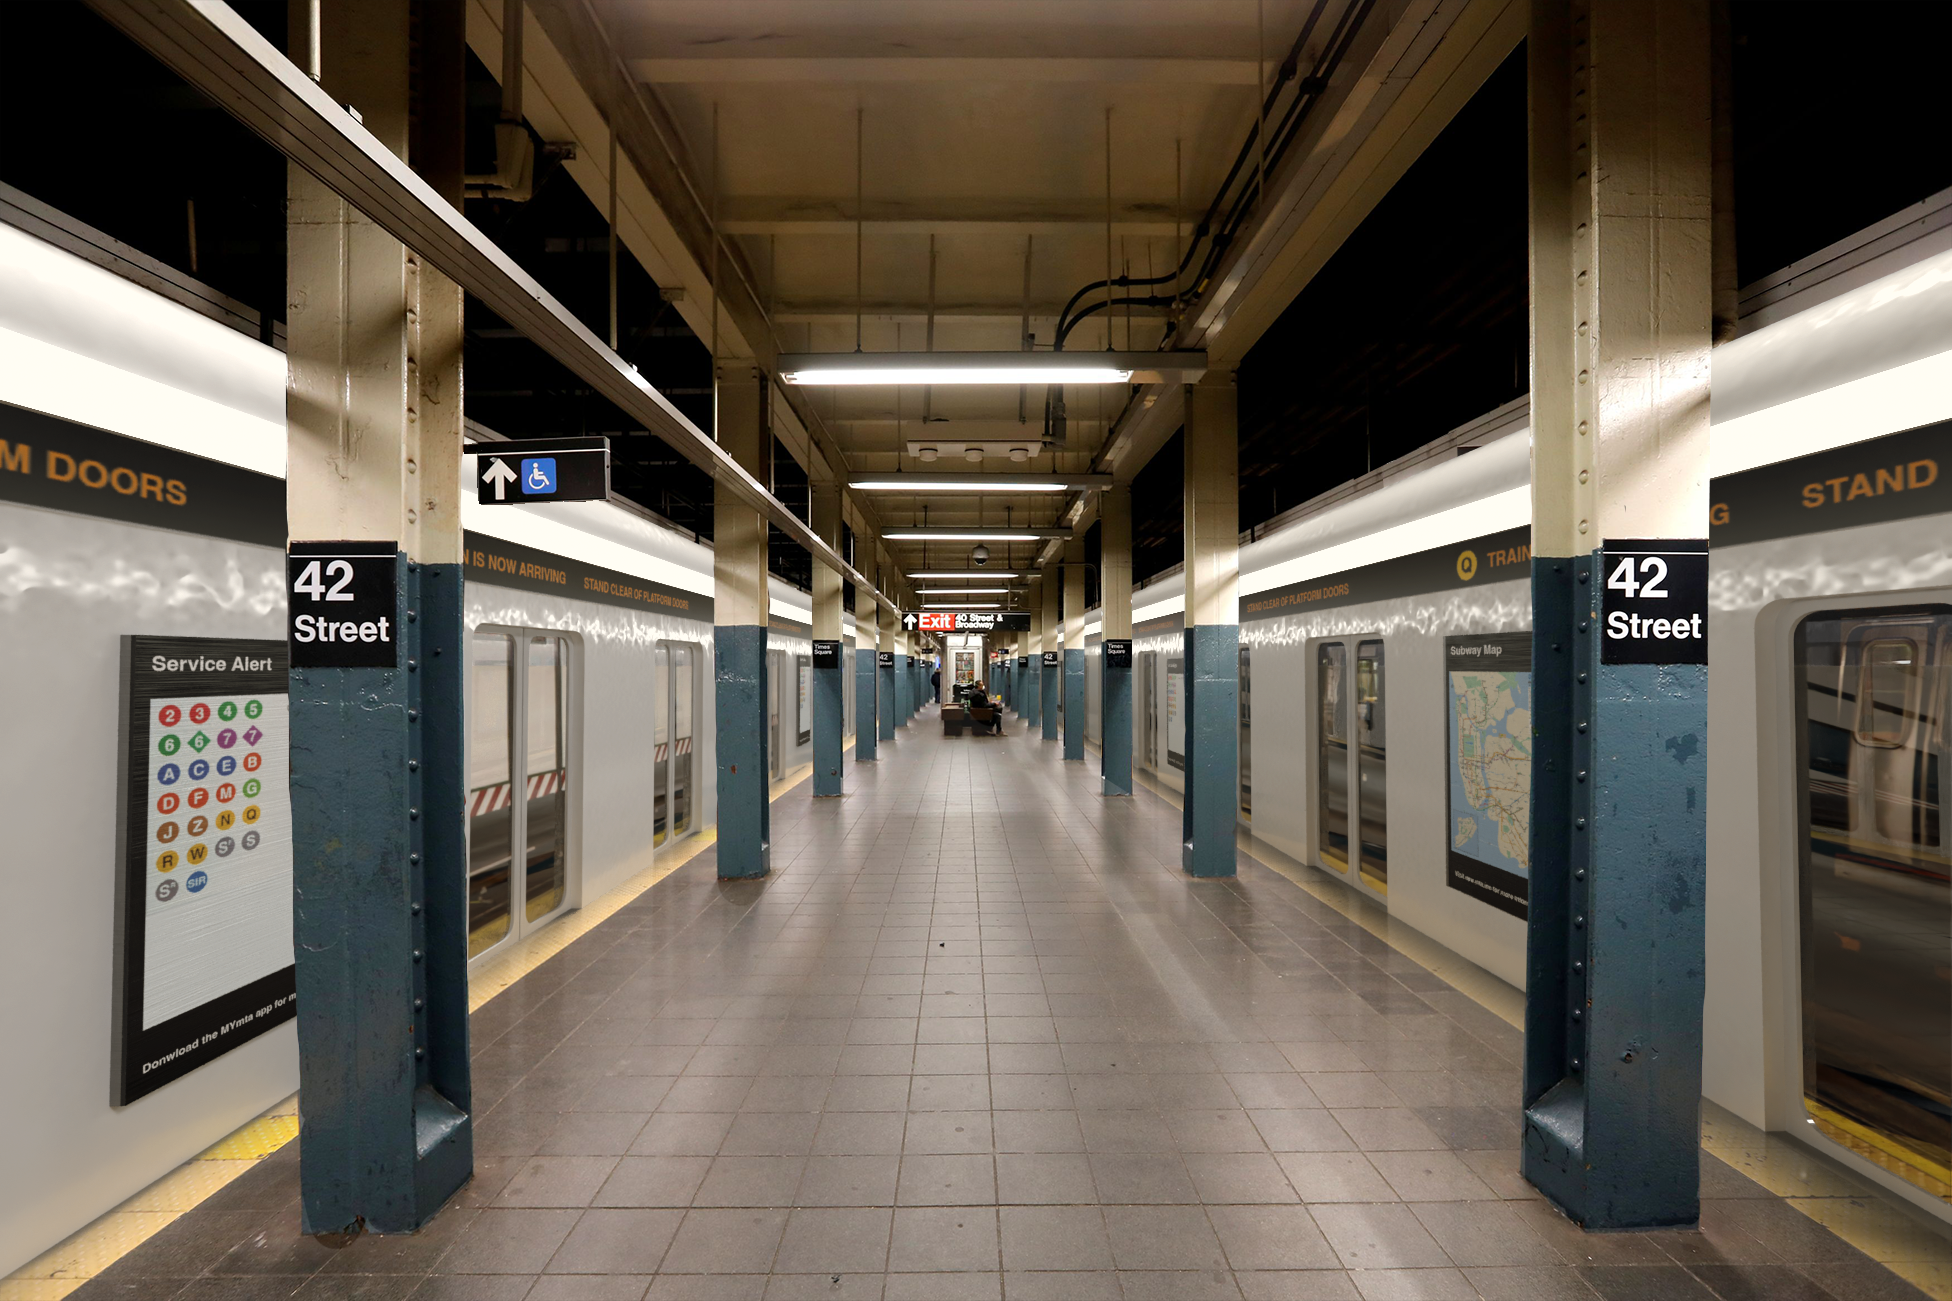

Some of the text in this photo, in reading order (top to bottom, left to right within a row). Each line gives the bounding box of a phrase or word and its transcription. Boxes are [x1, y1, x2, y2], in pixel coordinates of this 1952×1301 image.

[46, 450, 188, 506] DOORS
[1802, 459, 1938, 508] STAND
[473, 551, 485, 568] IS
[488, 554, 517, 575] NOW
[519, 562, 567, 585] ARRIVING
[1487, 544, 1532, 568] TRAIN
[294, 560, 354, 601] 42
[1607, 557, 1669, 598] 42
[584, 577, 609, 594] STAND
[610, 583, 633, 599] CLEAR
[634, 589, 642, 600] OF
[643, 591, 672, 607] PLATFORM
[1289, 588, 1322, 605] PLATFORM
[1323, 583, 1349, 599] DOORS
[294, 614, 390, 643] Street
[919, 613, 950, 629] Exit
[955, 613, 1003, 622] 40 Street &
[955, 621, 994, 630] Broadway
[1606, 611, 1702, 639] Street
[152, 655, 272, 672] Service Alert
[1450, 644, 1502, 657] Subway Map
[188, 875, 206, 888] SIR
[142, 1038, 198, 1074] Donwload
[202, 1031, 218, 1044] the
[220, 1014, 254, 1036] MYmta
[256, 1004, 272, 1018] app
[274, 996, 286, 1009] for
